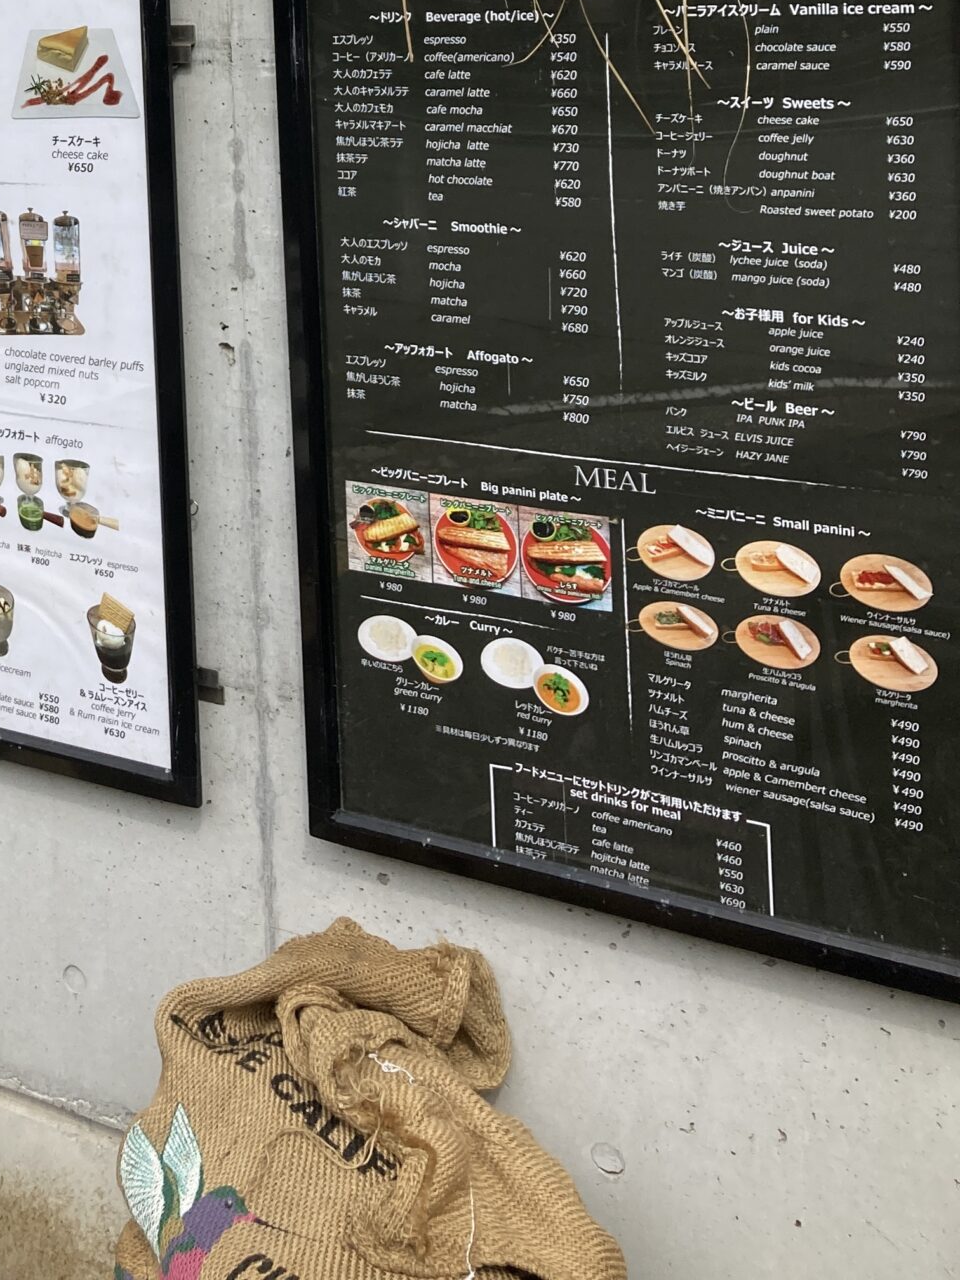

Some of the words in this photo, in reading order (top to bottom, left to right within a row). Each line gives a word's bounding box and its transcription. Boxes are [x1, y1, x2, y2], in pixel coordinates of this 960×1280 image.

[789, 3, 838, 16] Vanilla
[868, 3, 914, 14] cream
[426, 11, 481, 24] Beverage
[755, 24, 779, 35] plain
[883, 23, 910, 33] ¥550
[332, 35, 373, 45] エスプレッソ
[424, 36, 466, 47] espresso
[755, 42, 803, 52] chocolate
[806, 43, 836, 52] sauce
[883, 42, 910, 51] ¥580
[551, 52, 577, 62] ¥540
[756, 61, 796, 70] caramel
[800, 61, 830, 70] sauce
[333, 69, 392, 79] 大人のカフェラテ
[448, 70, 471, 79] latte
[334, 86, 410, 96] 大人のキャラメルラテ
[425, 87, 464, 97] caramel
[467, 88, 490, 97] latte
[551, 89, 577, 98] ¥660
[335, 103, 393, 113] 大人のカフェモカ
[450, 106, 482, 115] mocha
[782, 97, 834, 109] Sweets
[425, 123, 464, 132] caramel
[757, 115, 792, 125] cheese
[796, 115, 819, 125] cake
[886, 116, 913, 127] ¥650
[52, 135, 101, 147] チーズケーキ
[758, 133, 789, 143] coffee
[426, 140, 460, 151] hojicha
[467, 141, 489, 150] latte
[553, 143, 579, 153] ¥730
[52, 149, 84, 159] cheese
[86, 150, 108, 160] cake
[337, 153, 368, 163] 抹茶ラテ
[427, 157, 461, 167] matcha
[759, 151, 808, 162] doughnut
[888, 154, 915, 164] ¥360
[68, 163, 93, 173] ¥650
[447, 175, 493, 185] chocolate
[759, 170, 809, 181] doughnut
[812, 170, 835, 181] boat
[888, 173, 915, 183] ¥630
[338, 187, 356, 197] 紅茶
[428, 192, 443, 201] tea
[555, 197, 581, 207] ¥580
[760, 205, 801, 216] Roasted
[805, 207, 835, 217] sweet
[839, 208, 873, 220] potato
[889, 210, 916, 220] ¥200
[451, 221, 507, 234] Smoothie
[427, 244, 470, 256] espresso
[781, 243, 818, 255] Juice
[341, 255, 381, 266] 大人のモカ
[429, 262, 461, 271] mocha
[559, 269, 586, 280] ¥660
[430, 278, 465, 290] hojicha
[560, 287, 587, 298] ¥720
[732, 274, 766, 285] mango
[768, 275, 793, 286] juice
[893, 282, 921, 292] ¥480
[431, 296, 467, 307] matcha
[344, 305, 377, 317] キャラメル
[431, 313, 470, 324] caramel
[562, 322, 588, 334] ¥680
[818, 314, 848, 327] Kids
[4, 347, 46, 360] chocolate
[50, 352, 85, 364] covered
[90, 356, 117, 369] barley
[120, 361, 144, 371] puffs
[467, 350, 519, 365] Affogato
[769, 344, 804, 356] orange
[898, 354, 924, 365] ¥240
[4, 362, 44, 373] unglazed
[48, 366, 75, 377] mixed
[79, 370, 98, 380] nuts
[793, 364, 821, 374] cocoa
[5, 375, 20, 384] salt
[24, 377, 59, 389] popcorn
[439, 381, 475, 394] hojicha
[440, 399, 477, 411] matcha
[785, 402, 818, 416] Beer
[45, 436, 83, 448] affogato
[574, 465, 656, 494] MEAL
[902, 468, 928, 479] ¥790
[481, 481, 499, 495] Big
[502, 485, 536, 500] panini
[539, 490, 568, 506] plate
[773, 517, 810, 532] Small
[814, 522, 855, 537] panini
[470, 621, 500, 635] Curry
[39, 693, 59, 704] ¥550
[14, 697, 34, 708] sauce
[39, 702, 59, 714] ¥580
[91, 703, 115, 714] coffee
[721, 688, 778, 706] margherita
[891, 719, 920, 732] ¥490
[16, 709, 36, 719] sauce
[40, 713, 59, 724] ¥580
[722, 703, 746, 714] tuna
[760, 709, 795, 726] cheese
[891, 735, 920, 748] ¥490
[104, 727, 125, 739] ¥630
[758, 725, 794, 741] cheese
[724, 735, 762, 750] spinach
[892, 768, 921, 782] ¥490
[780, 762, 820, 777] arugula
[829, 788, 866, 804] cheese
[570, 789, 589, 801] set
[591, 792, 628, 809] drinks
[631, 801, 650, 812] for
[652, 805, 682, 820] meal
[591, 811, 620, 824] coffee
[894, 818, 923, 832] ¥490
[592, 824, 607, 834] tea
[717, 853, 742, 866] ¥460
[614, 841, 634, 854] latte
[719, 867, 743, 880] ¥550
